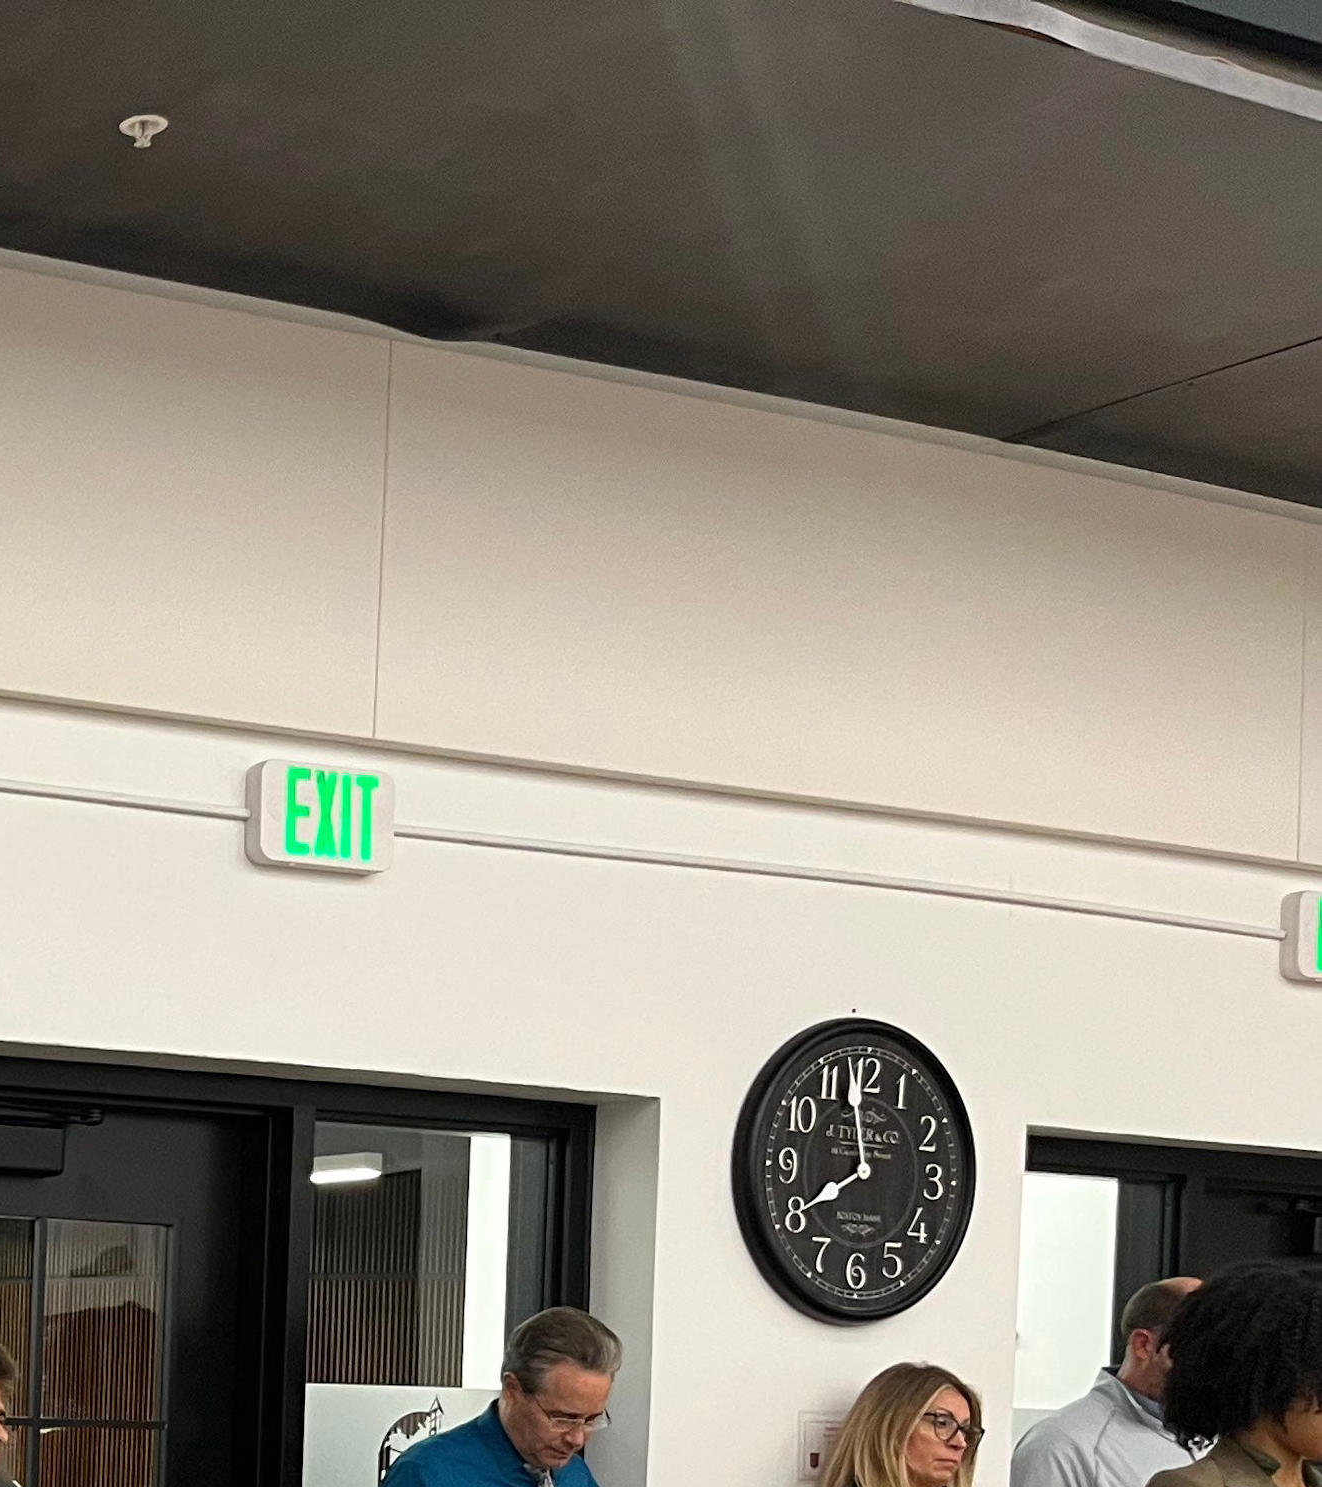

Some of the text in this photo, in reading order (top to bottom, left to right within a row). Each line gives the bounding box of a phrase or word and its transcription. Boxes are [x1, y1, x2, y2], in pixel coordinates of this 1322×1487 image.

[284, 766, 380, 862] EXIT
[819, 1065, 839, 1101] 11
[894, 1073, 907, 1110] 1
[787, 1096, 817, 1133] 10
[919, 1115, 937, 1152] 2
[778, 1147, 798, 1184] 9
[923, 1163, 944, 1201] 3
[785, 1196, 806, 1234] 8
[907, 1207, 928, 1244] 4
[812, 1236, 832, 1274] 7
[845, 1252, 867, 1290] 6
[882, 1241, 903, 1279] 5
